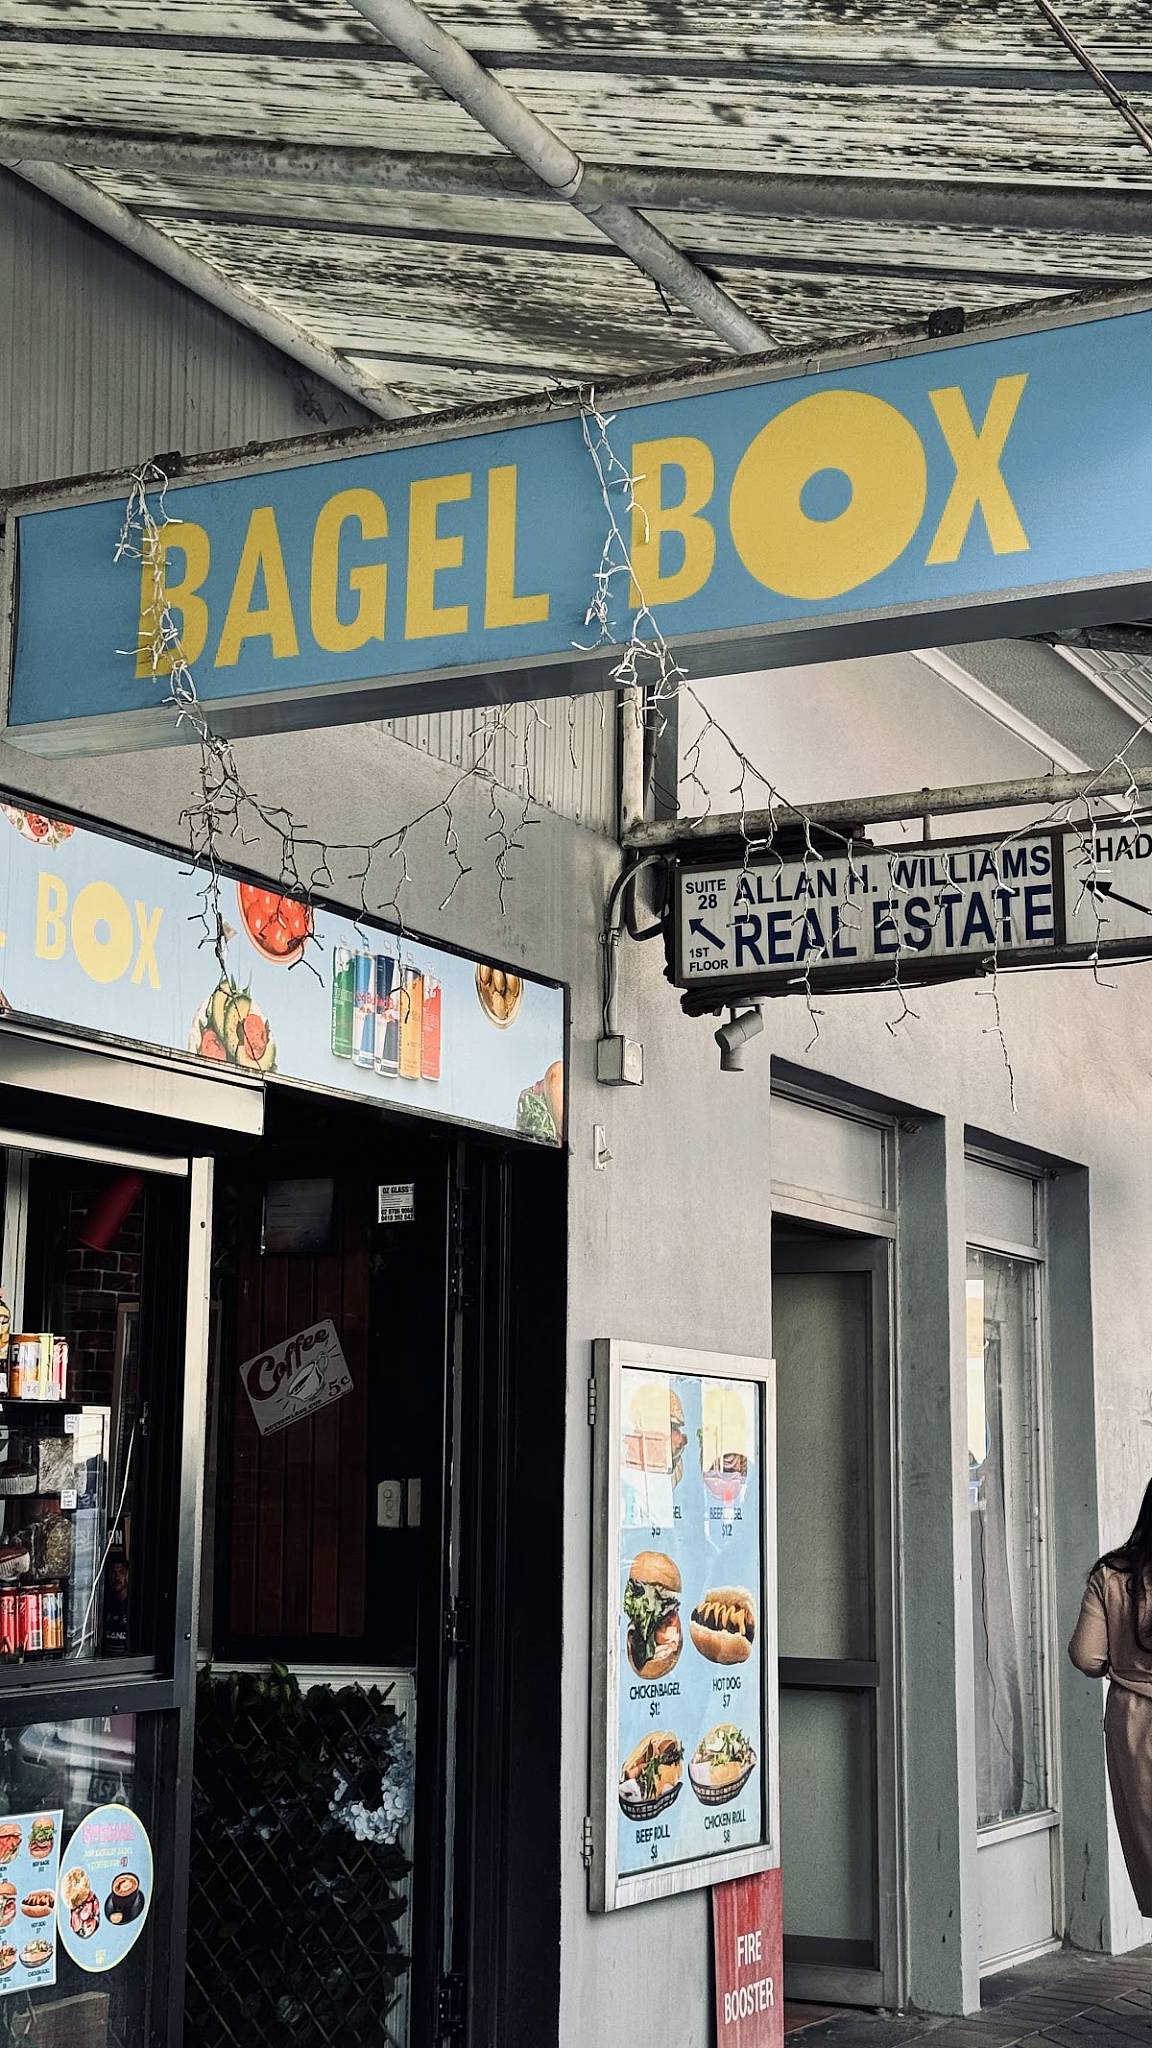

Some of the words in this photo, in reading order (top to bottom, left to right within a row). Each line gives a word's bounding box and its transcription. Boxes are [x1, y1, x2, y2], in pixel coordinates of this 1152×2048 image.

[135, 464, 550, 679] BAGEL
[628, 372, 1031, 609] BOX
[685, 879, 727, 894] SUITE
[733, 868, 837, 906] ALLAN
[889, 845, 1050, 888] WILLIAMS
[698, 894, 718, 910] 28
[35, 871, 164, 991] BOX
[734, 906, 857, 967] REAL
[873, 884, 1054, 954] ESTATE
[689, 947, 710, 959] 1ST
[689, 959, 729, 972] FLOOR
[247, 1328, 330, 1401] Coffee
[712, 1678, 726, 1691] HOT
[726, 1676, 741, 1690] DOG
[732, 1808, 747, 1824] ROLL
[636, 1828, 653, 1844] BEEF
[736, 1930, 762, 1968] FIRE
[724, 1976, 775, 2025] BOOSTER
